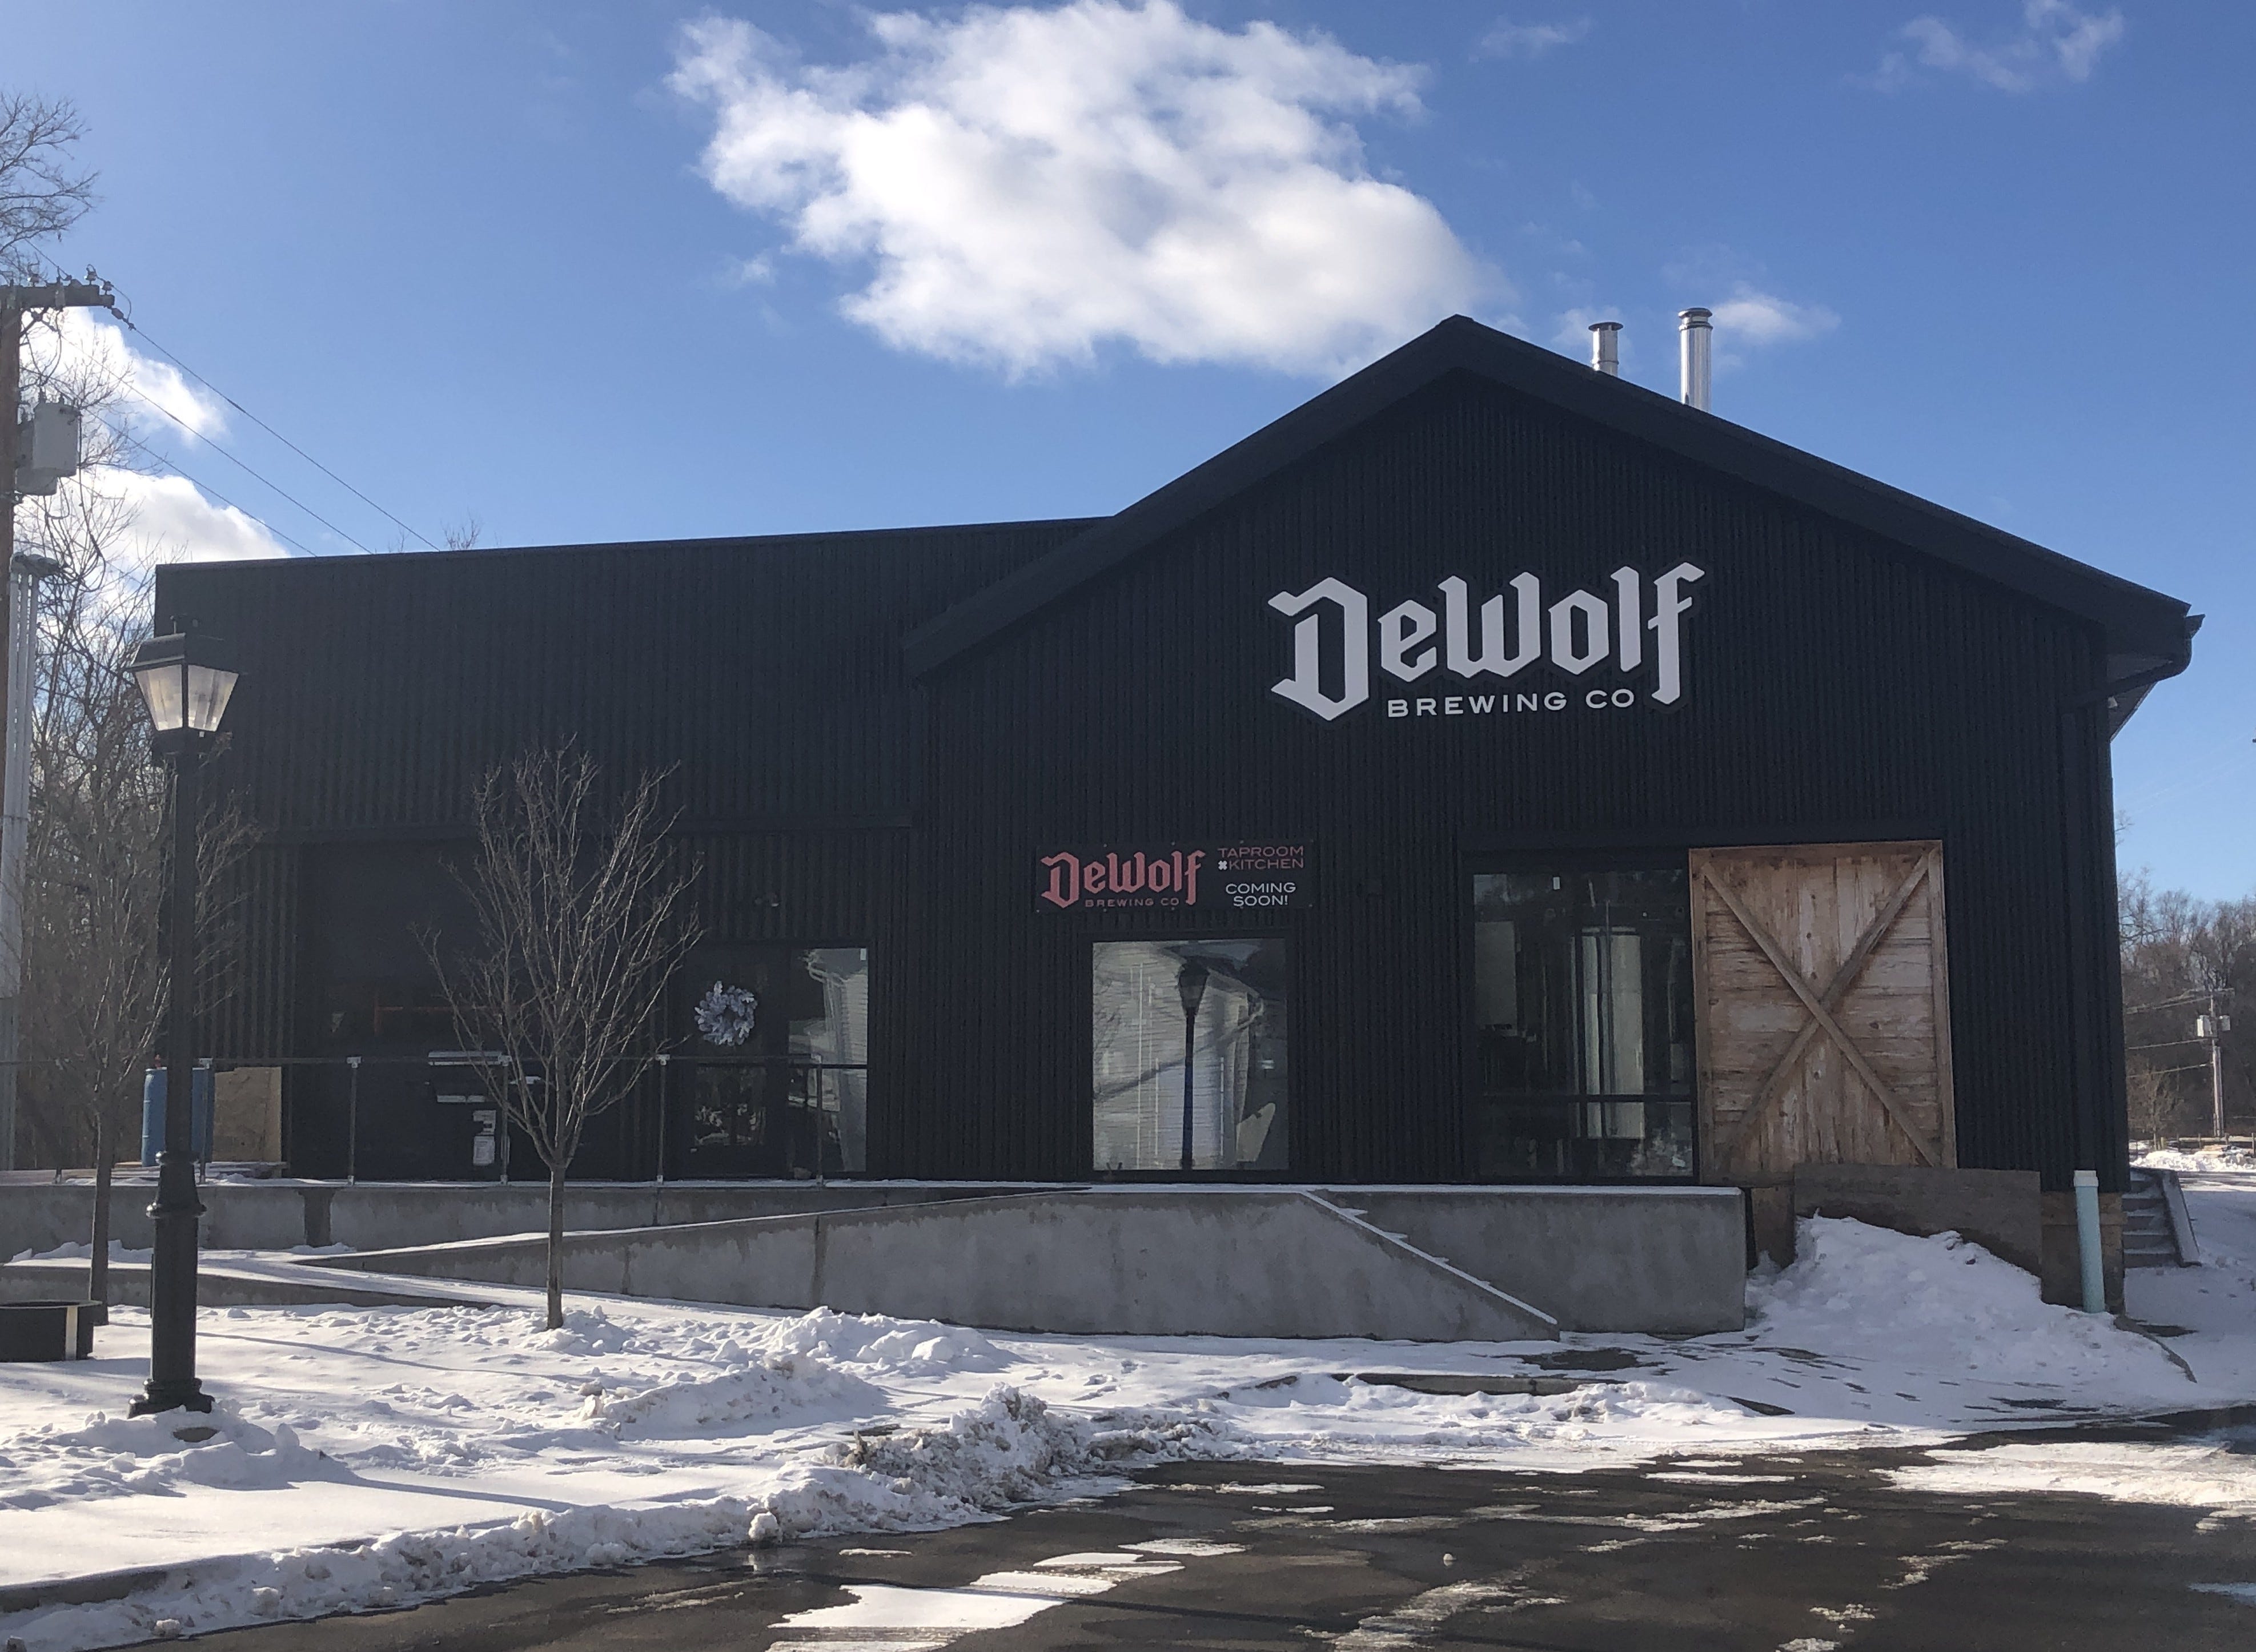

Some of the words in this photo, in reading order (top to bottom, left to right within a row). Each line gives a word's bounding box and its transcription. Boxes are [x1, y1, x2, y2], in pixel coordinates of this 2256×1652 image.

[1268, 562, 1705, 721] DeWolf
[1388, 692, 1568, 718] BREWING
[1585, 689, 1635, 709] CO
[1218, 845, 1304, 858] TAPROOM
[1229, 858, 1304, 870] KITCHEN
[1040, 851, 1206, 909] DeWolf
[1226, 882, 1296, 894] COMING
[1085, 898, 1154, 907] BREWING
[1161, 897, 1180, 906] CO
[1234, 895, 1288, 907] SOON!
